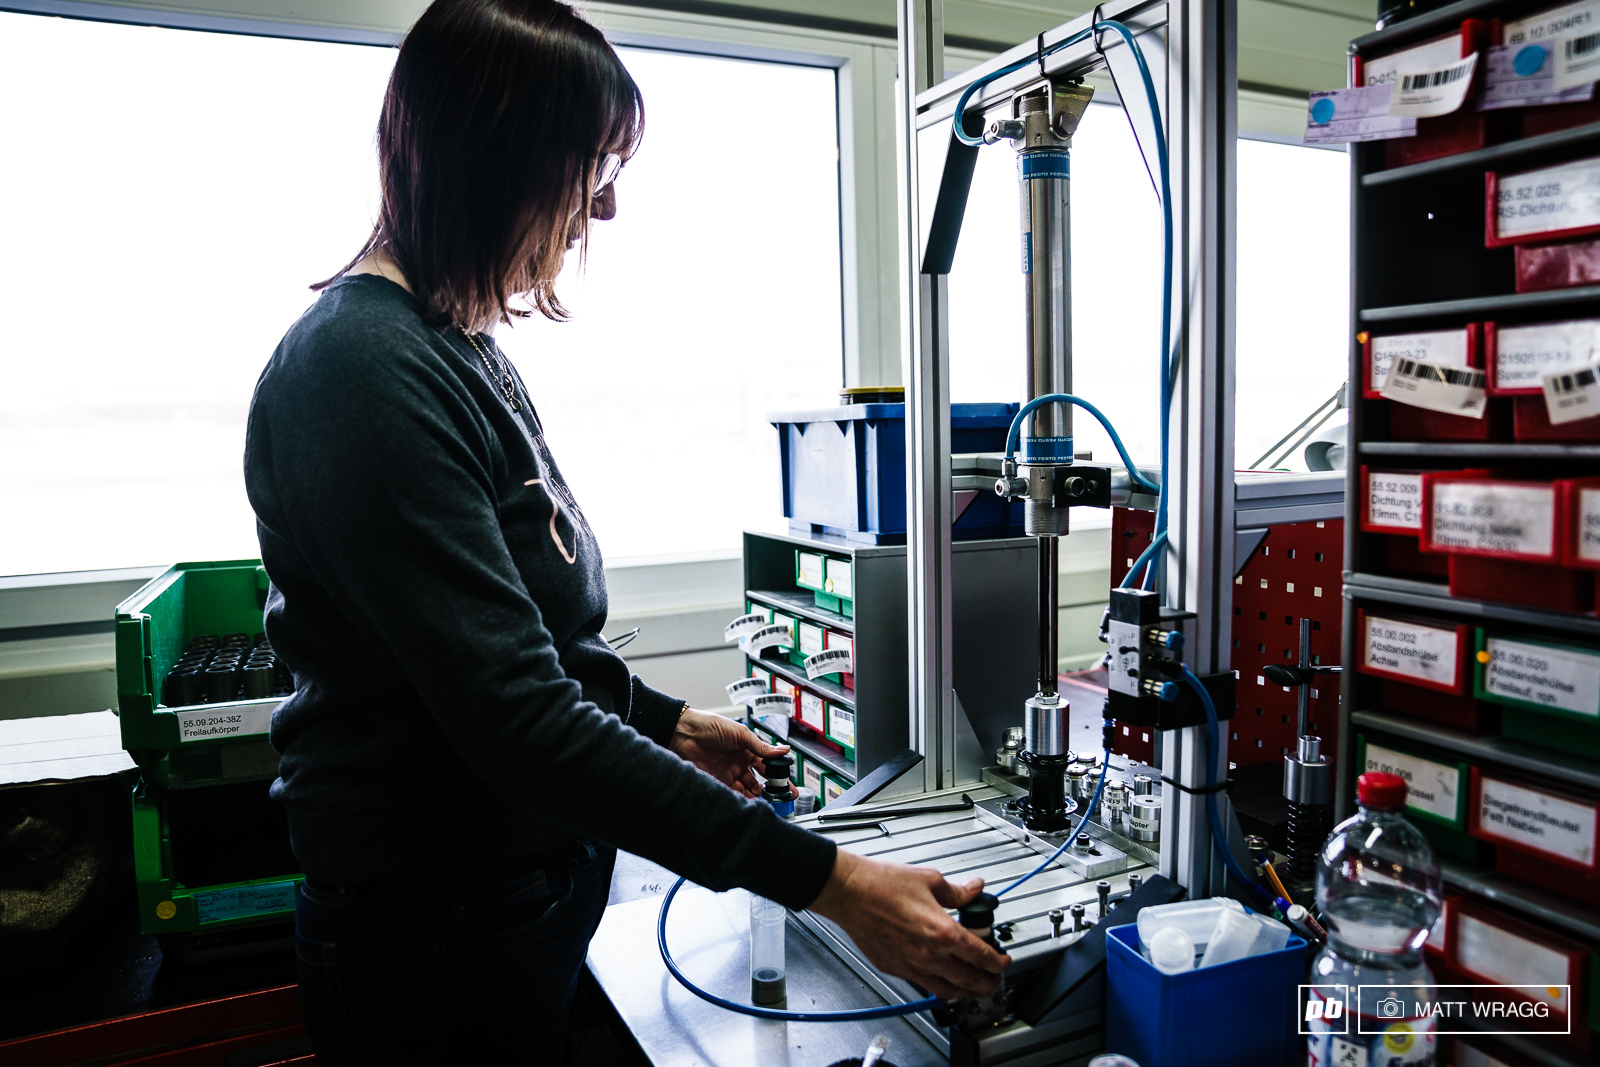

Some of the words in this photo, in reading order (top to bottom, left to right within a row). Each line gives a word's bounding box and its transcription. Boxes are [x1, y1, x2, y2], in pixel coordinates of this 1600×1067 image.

[1370, 653, 1399, 667] Achse
[183, 715, 242, 728] 55.09.204-38Z
[183, 725, 240, 738] Freilaufkörper
